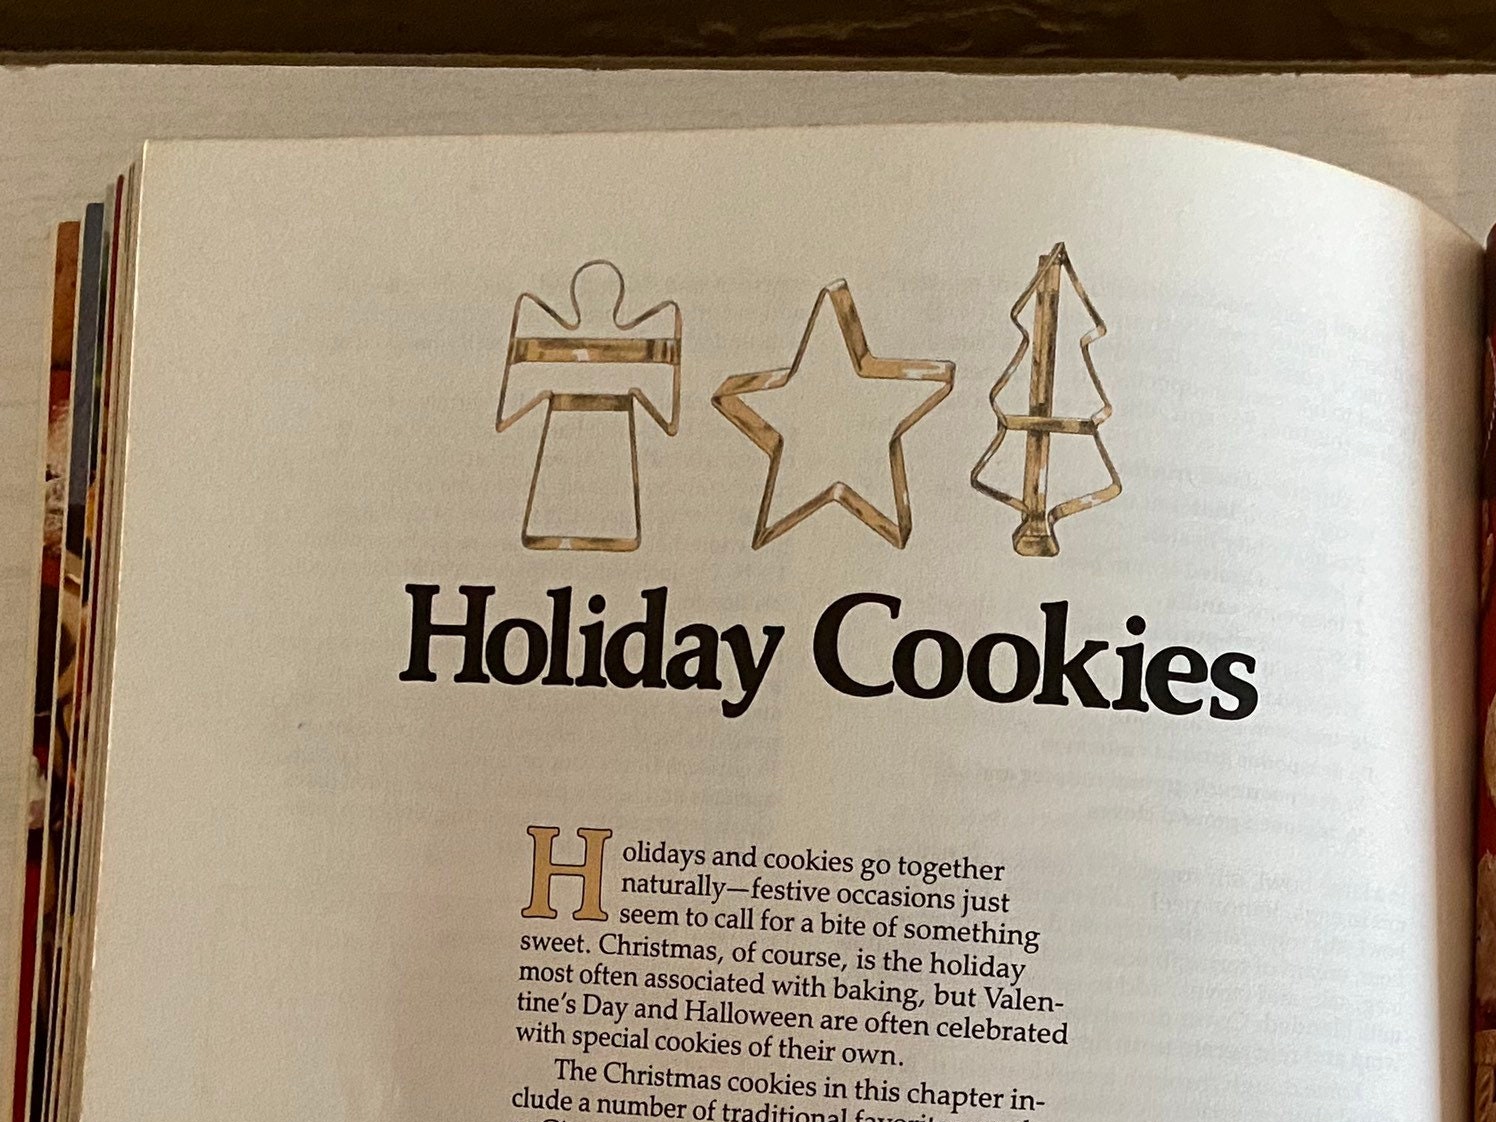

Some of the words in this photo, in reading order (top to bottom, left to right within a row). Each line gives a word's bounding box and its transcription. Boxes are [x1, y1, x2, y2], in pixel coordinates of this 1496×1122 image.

[398, 583, 786, 719] Holiday
[812, 592, 1259, 721] Cookies
[711, 845, 758, 869] and
[763, 847, 855, 873] cookies
[859, 857, 891, 882] go
[897, 855, 1006, 885] together
[619, 907, 680, 927] seem
[685, 907, 709, 928] to
[713, 907, 755, 931] call
[759, 907, 796, 933] for
[800, 917, 815, 934] a
[819, 911, 867, 937] bite
[872, 915, 899, 939] of
[903, 919, 1041, 955] something
[519, 933, 591, 955] sweet.
[598, 932, 725, 966] Christmas,
[731, 939, 757, 963] of
[761, 948, 848, 973] course,
[855, 947, 877, 971] is
[882, 949, 923, 974] the
[928, 951, 1027, 987] holiday
[517, 963, 575, 984] most
[579, 961, 639, 987] often
[643, 969, 765, 995] associated
[771, 974, 827, 999] with
[833, 975, 925, 1012] baking,
[933, 981, 977, 1009] but
[983, 985, 1065, 1013] Valen-
[515, 1021, 567, 1045] with
[571, 1026, 650, 1055] special
[654, 1030, 742, 1057] cookies
[747, 1033, 774, 1059] of
[778, 1035, 837, 1062] their
[841, 1047, 904, 1067] own.
[553, 1057, 598, 1083] The
[603, 1061, 722, 1091] Christmas
[727, 1071, 817, 1098] cookies
[823, 1075, 849, 1099] in
[853, 1077, 901, 1103] this
[907, 1081, 1005, 1115] chapter
[1009, 1087, 1046, 1112] in-
